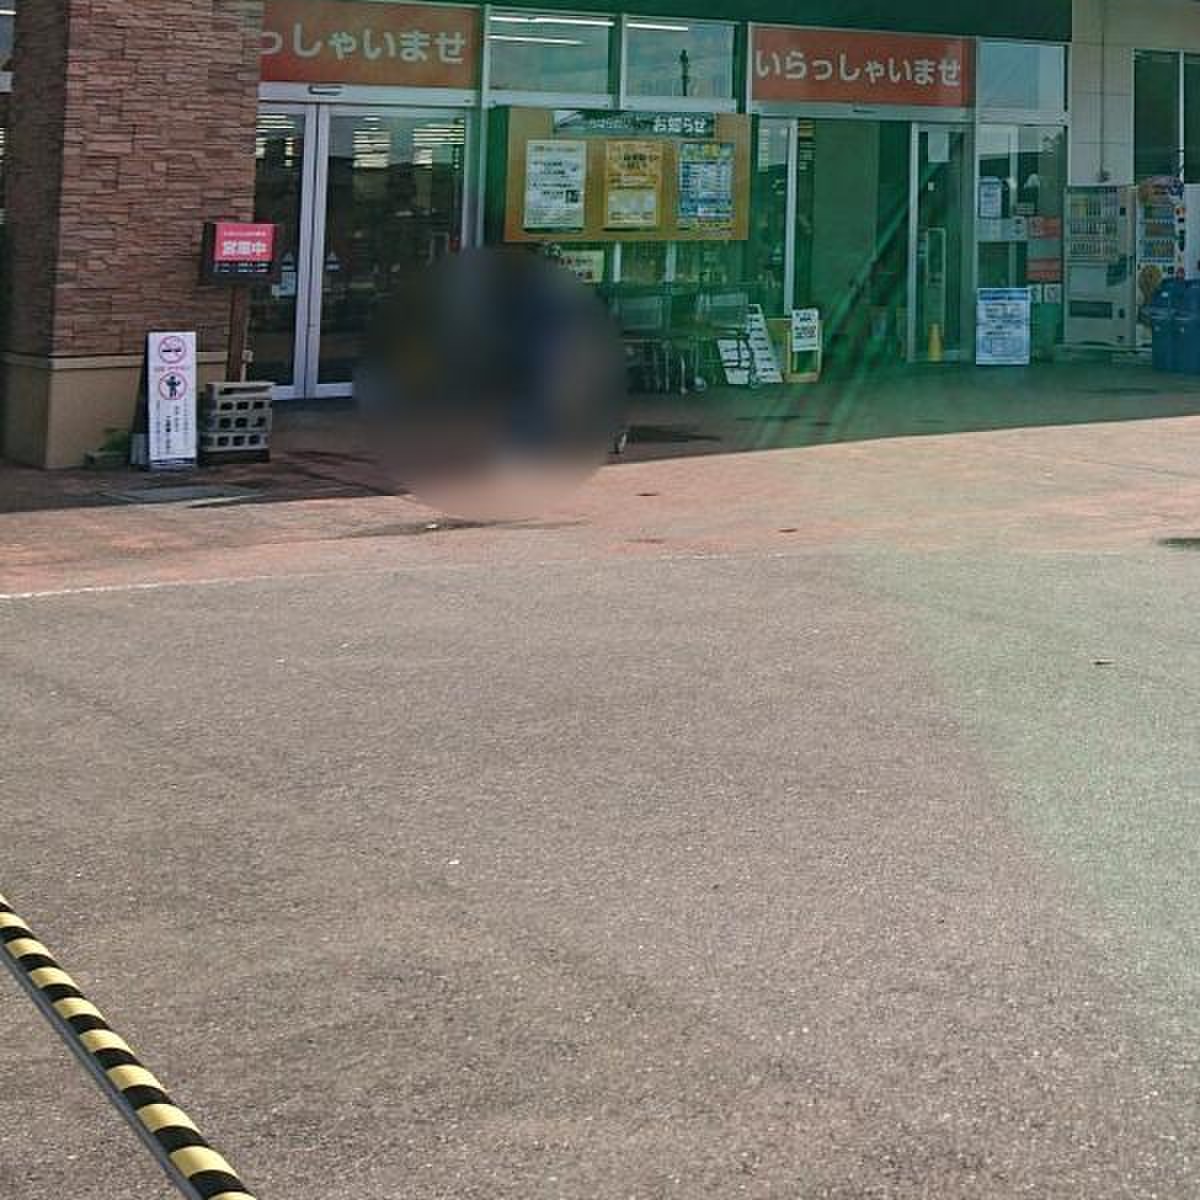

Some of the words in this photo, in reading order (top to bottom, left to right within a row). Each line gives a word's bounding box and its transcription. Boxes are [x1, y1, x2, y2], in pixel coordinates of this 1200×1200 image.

[756, 50, 961, 86] いらっしゃいませ
